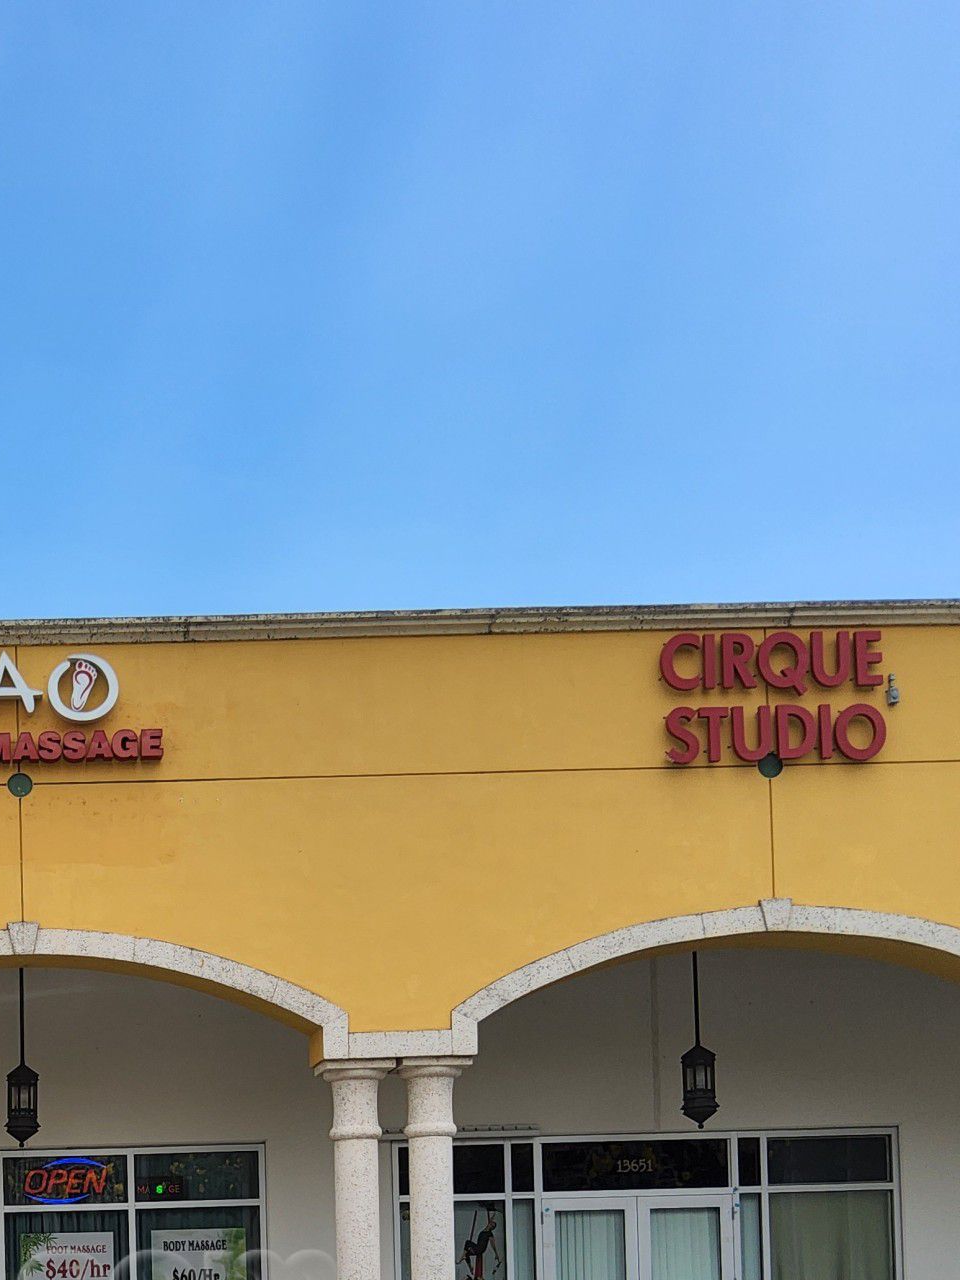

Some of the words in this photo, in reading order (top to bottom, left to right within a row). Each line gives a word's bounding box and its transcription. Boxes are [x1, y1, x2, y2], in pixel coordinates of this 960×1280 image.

[659, 630, 884, 696] CIRQUE
[664, 703, 887, 764] STUDIO
[616, 1159, 653, 1173] 13651
[24, 1167, 109, 1195] OPEN
[46, 1245, 68, 1255] FOOT
[69, 1244, 107, 1254] MASSAGE
[163, 1240, 186, 1252] BODY
[188, 1239, 227, 1251] MASSAGE
[45, 1258, 111, 1280] $40/hr
